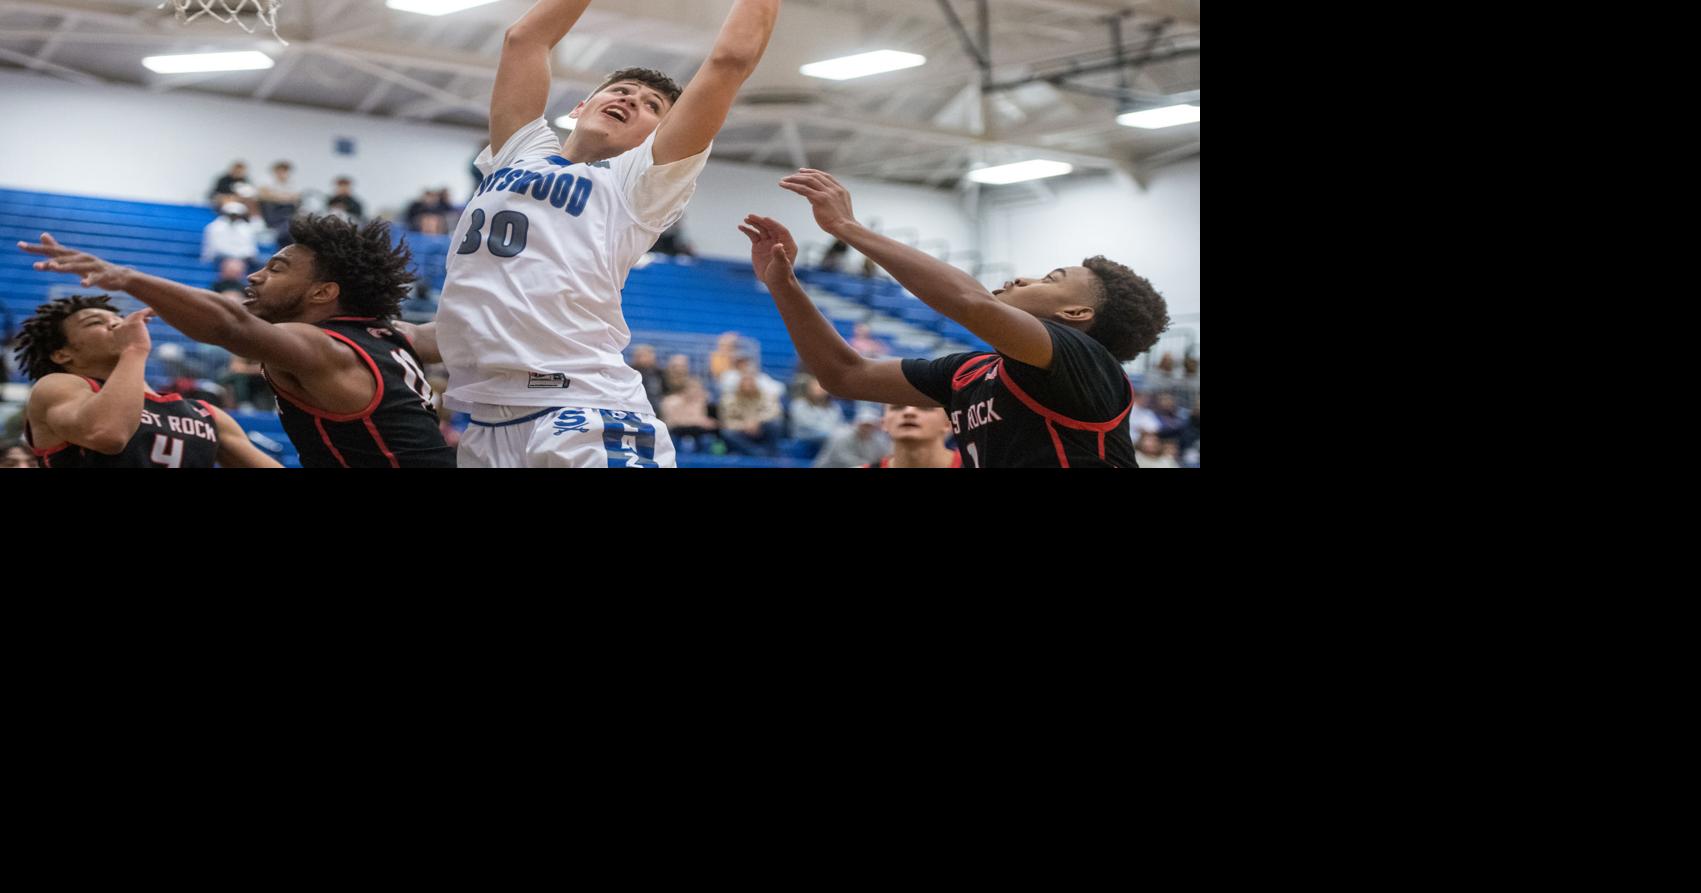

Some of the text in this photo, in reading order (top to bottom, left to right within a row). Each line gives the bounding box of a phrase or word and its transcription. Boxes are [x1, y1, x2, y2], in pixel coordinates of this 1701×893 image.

[456, 208, 529, 258] 30
[168, 415, 217, 443] ROCK
[149, 433, 184, 468] 4
